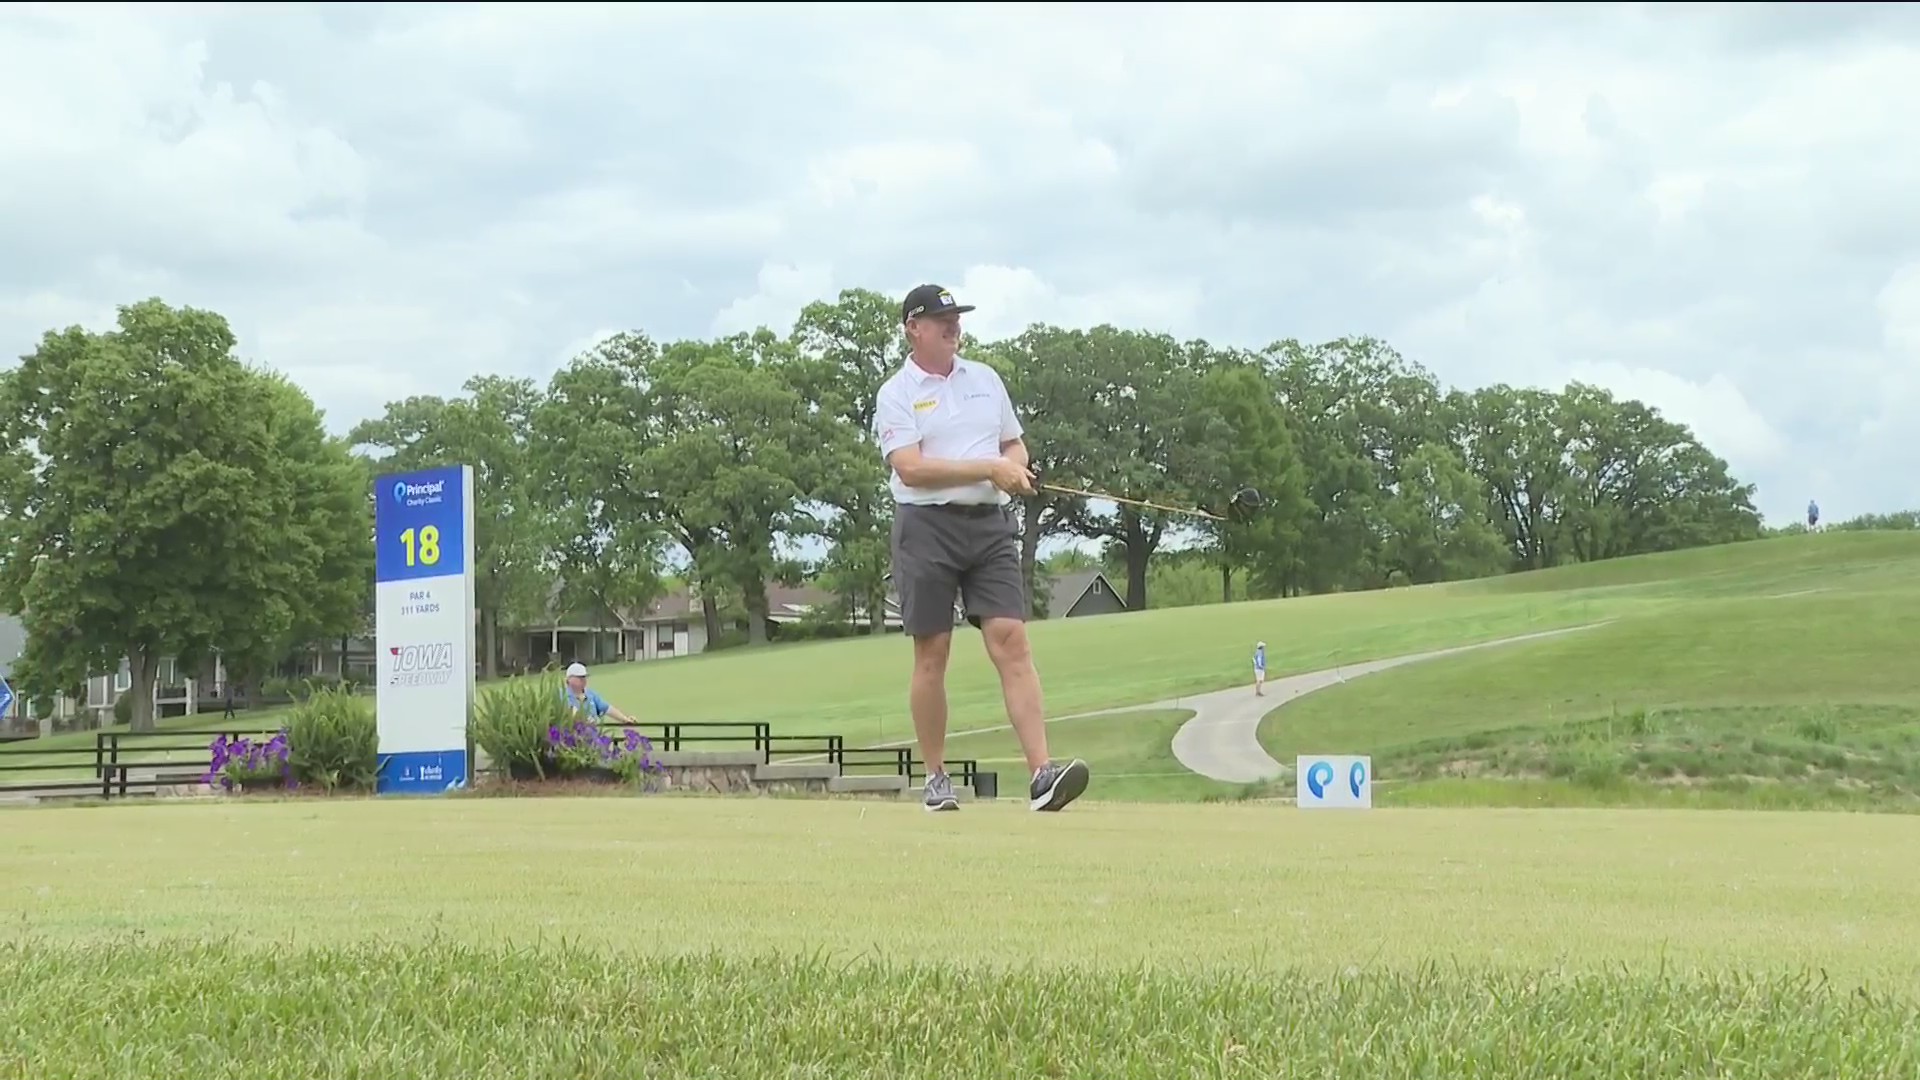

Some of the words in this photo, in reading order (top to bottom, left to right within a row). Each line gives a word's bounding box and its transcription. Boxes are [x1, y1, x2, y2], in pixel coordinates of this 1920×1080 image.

[406, 480, 443, 496] Principal
[399, 524, 440, 567] 18
[409, 591, 424, 601] PAR
[426, 591, 431, 599] 4
[415, 603, 440, 613] YARDS
[390, 642, 453, 672] IOWA
